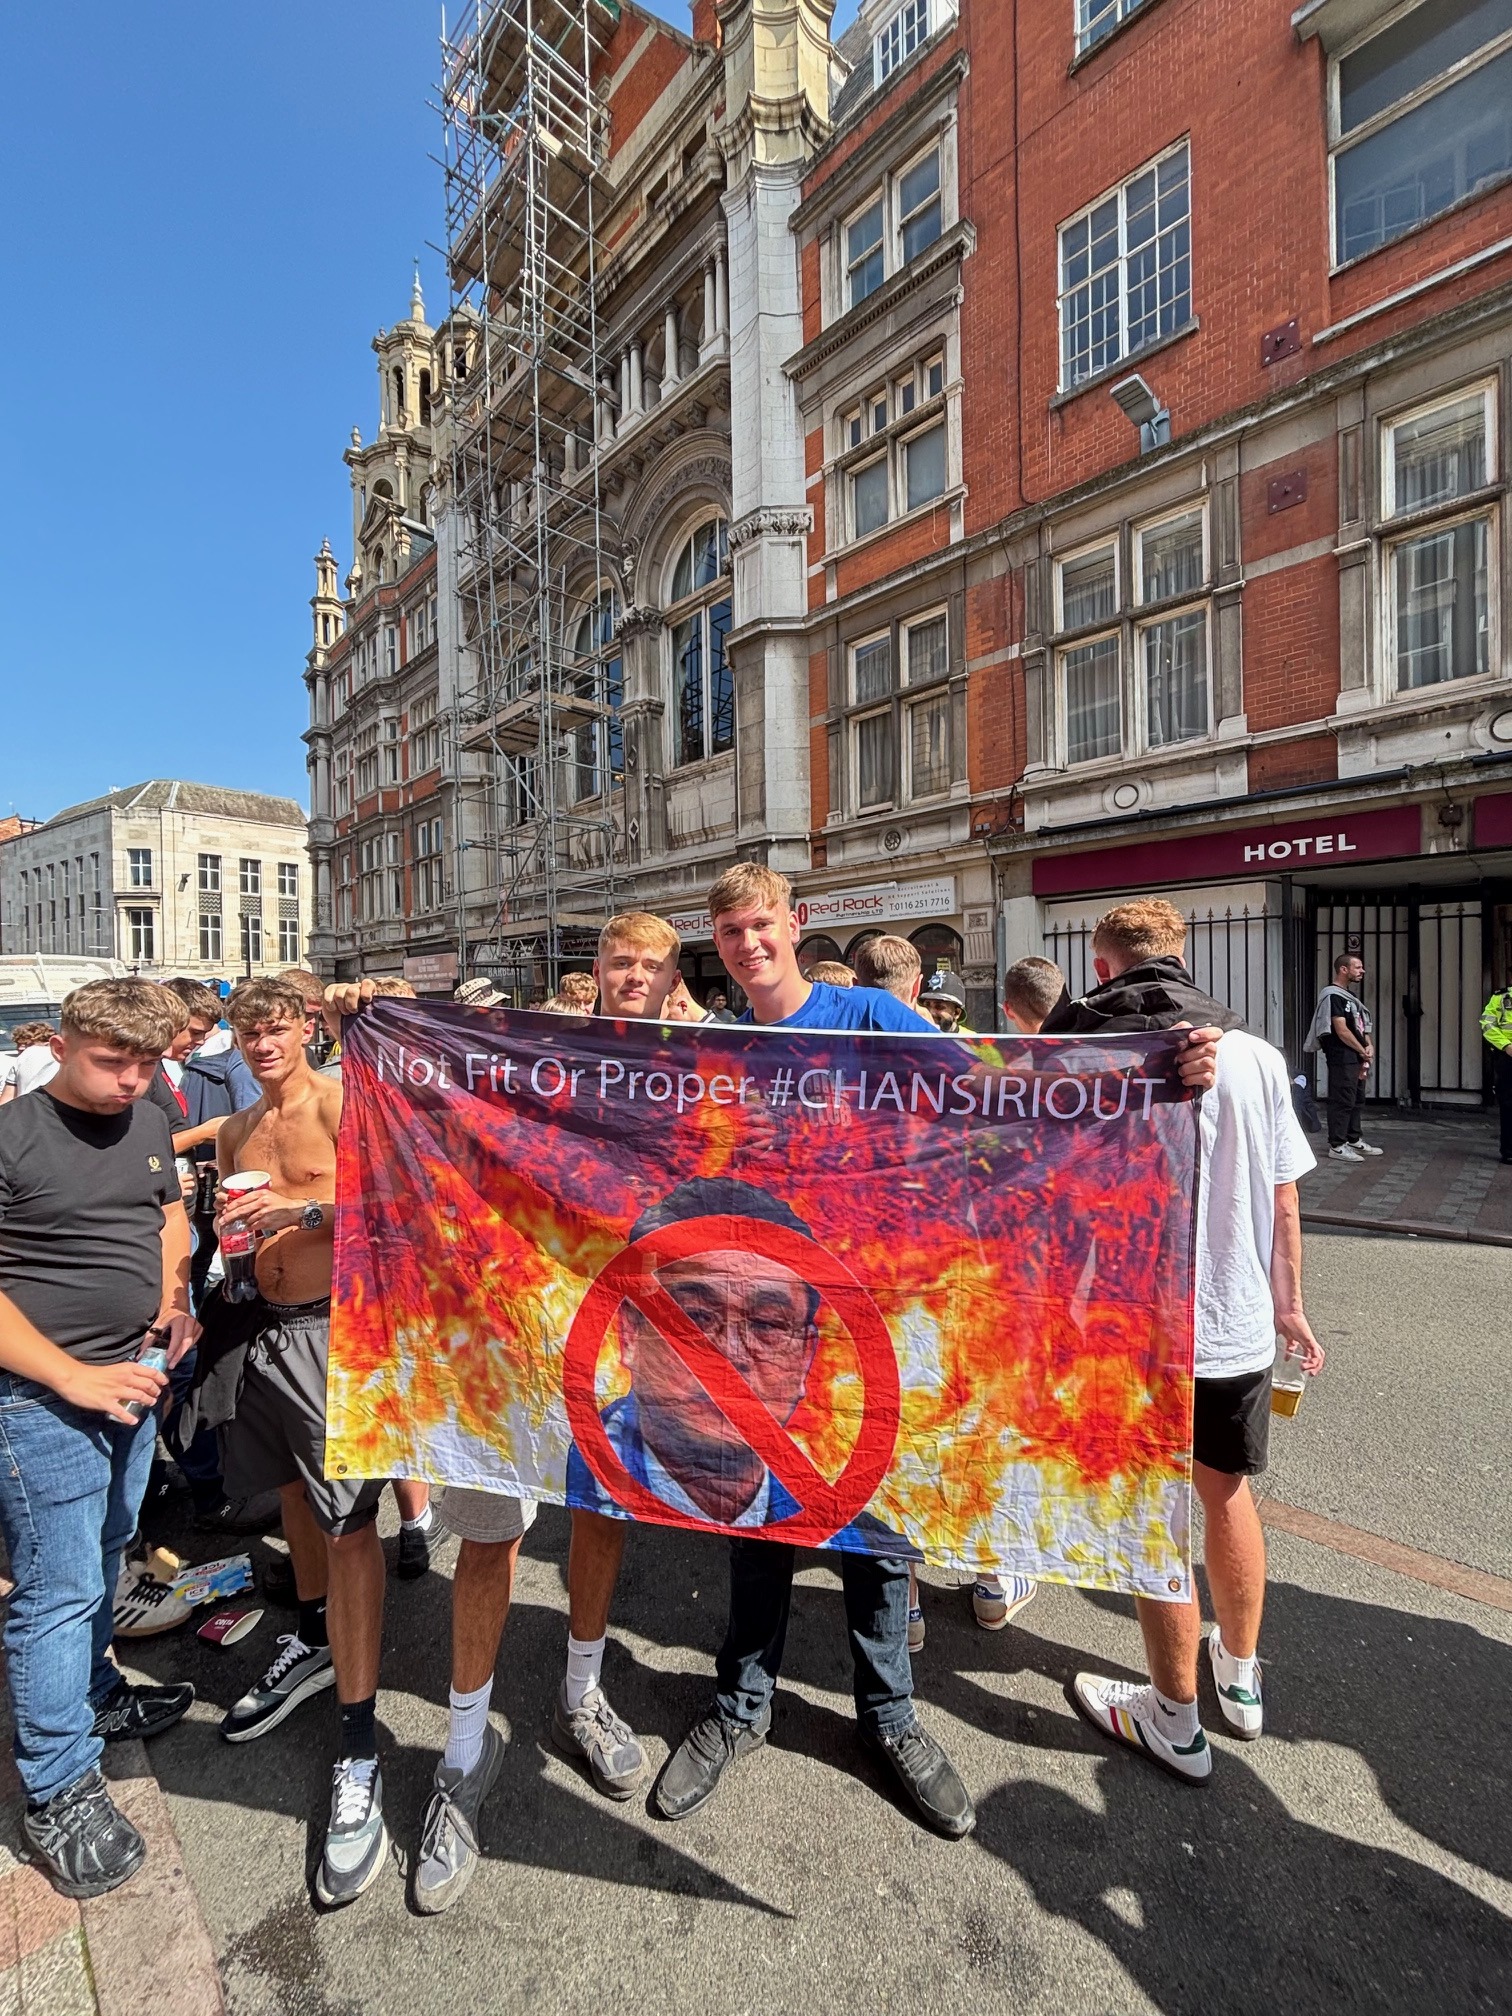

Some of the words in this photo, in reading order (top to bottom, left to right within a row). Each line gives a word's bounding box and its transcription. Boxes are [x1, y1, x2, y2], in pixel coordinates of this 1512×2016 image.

[1244, 833, 1357, 862] HOTEL
[809, 900, 840, 916] Red
[843, 895, 883, 912] Rock
[914, 899, 928, 909] 251
[930, 896, 950, 906] 7716
[674, 916, 700, 931] Red
[377, 1046, 452, 1090] Not
[465, 1053, 516, 1094] Fit
[530, 1057, 586, 1097] Or
[600, 1059, 755, 1113] Proper
[768, 1067, 1167, 1121] #CHANSIRIOUT
